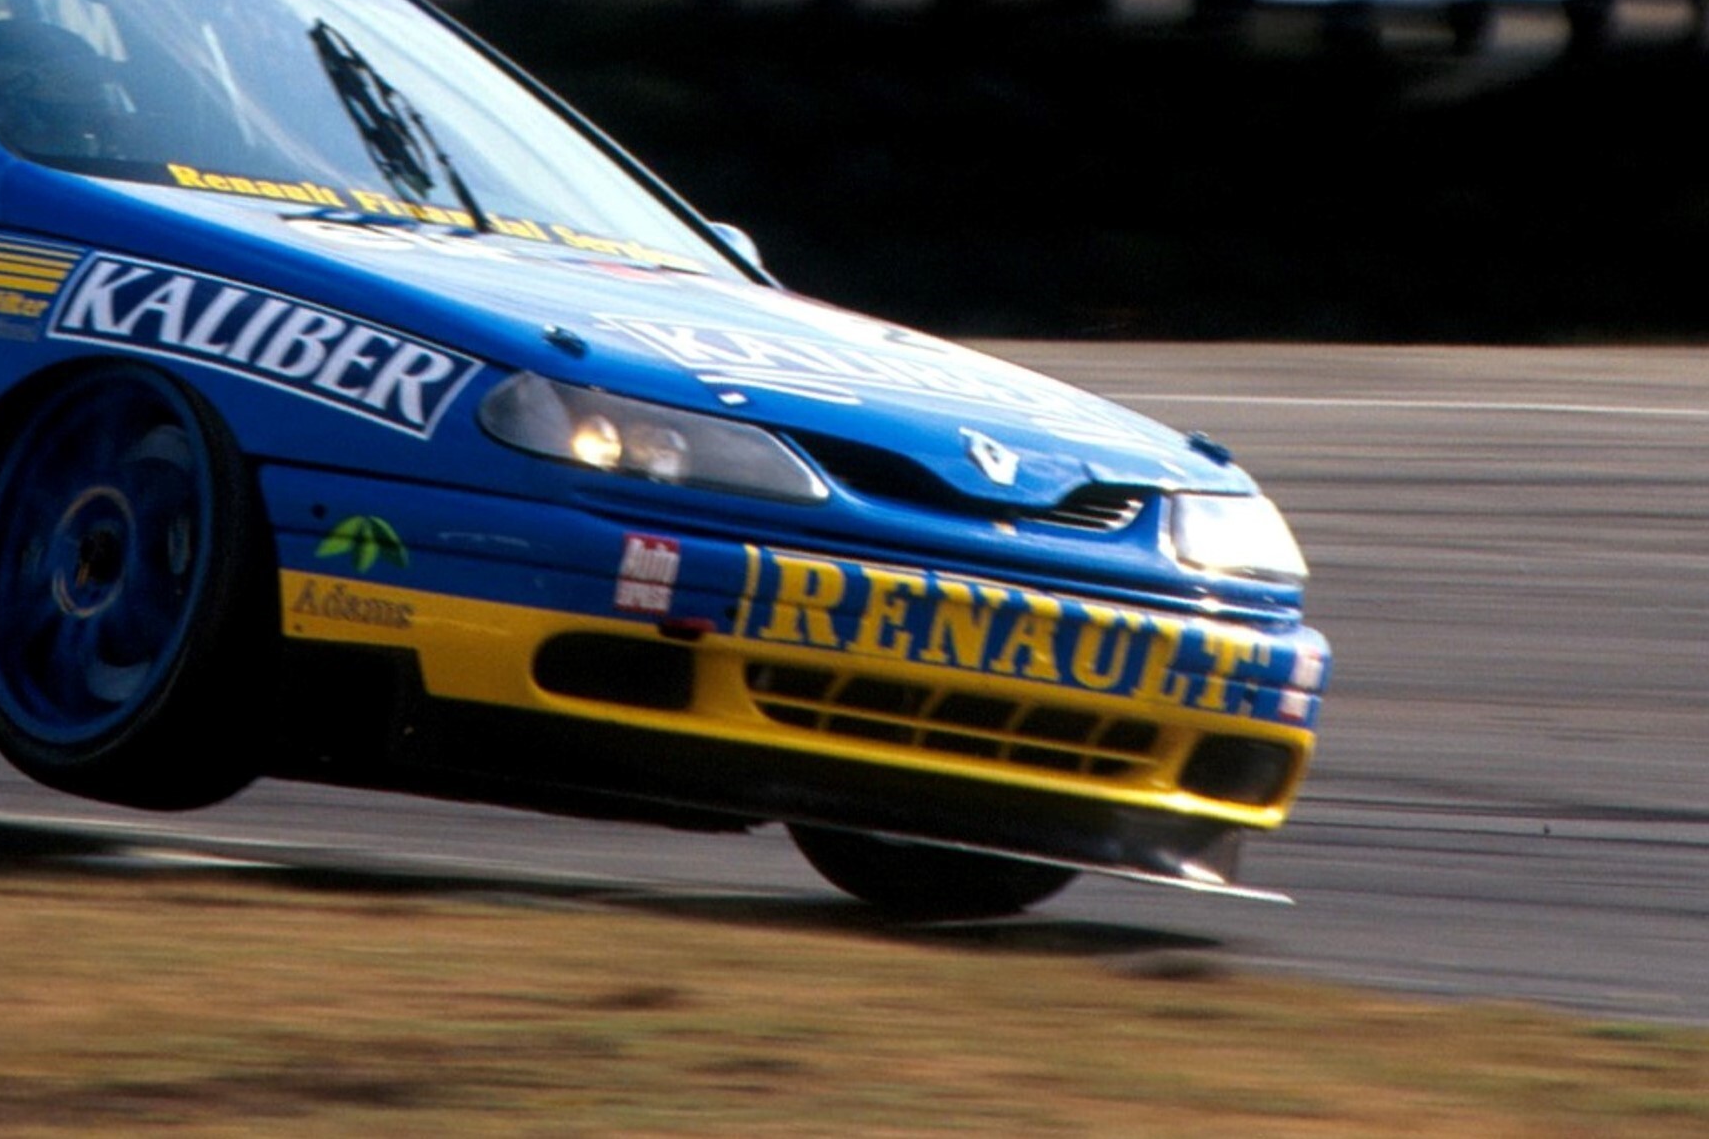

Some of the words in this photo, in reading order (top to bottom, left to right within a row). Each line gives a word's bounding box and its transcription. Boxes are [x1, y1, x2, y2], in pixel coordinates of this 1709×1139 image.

[167, 163, 348, 208] Renault
[349, 188, 552, 243] Finanial
[63, 258, 455, 425] KALIBER
[759, 554, 1252, 710] RENAULT
